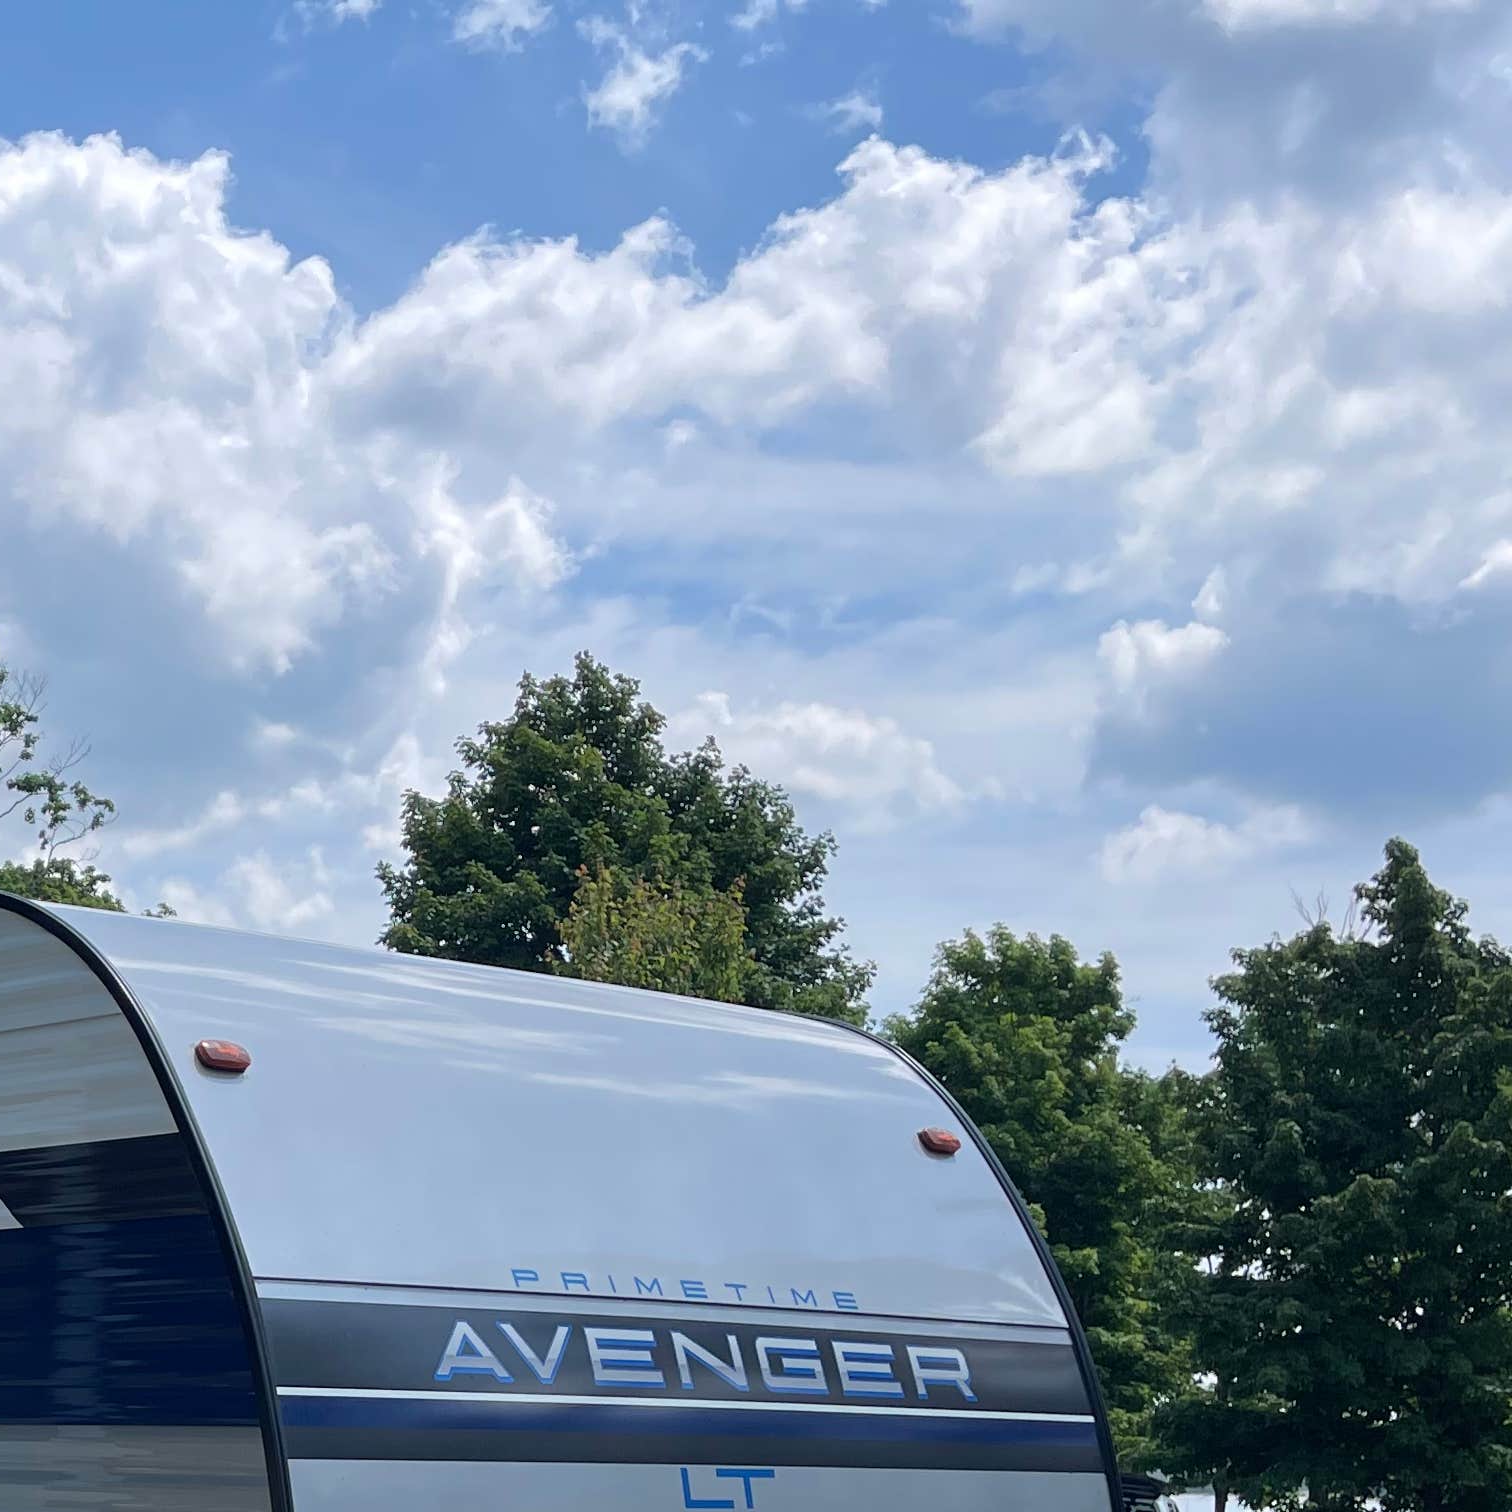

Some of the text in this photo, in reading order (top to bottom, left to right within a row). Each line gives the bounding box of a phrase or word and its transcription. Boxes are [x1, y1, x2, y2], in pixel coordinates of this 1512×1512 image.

[511, 1269, 859, 1310] PRIMETIME
[433, 1321, 978, 1402] AVENGER
[680, 1467, 775, 1509] LT
